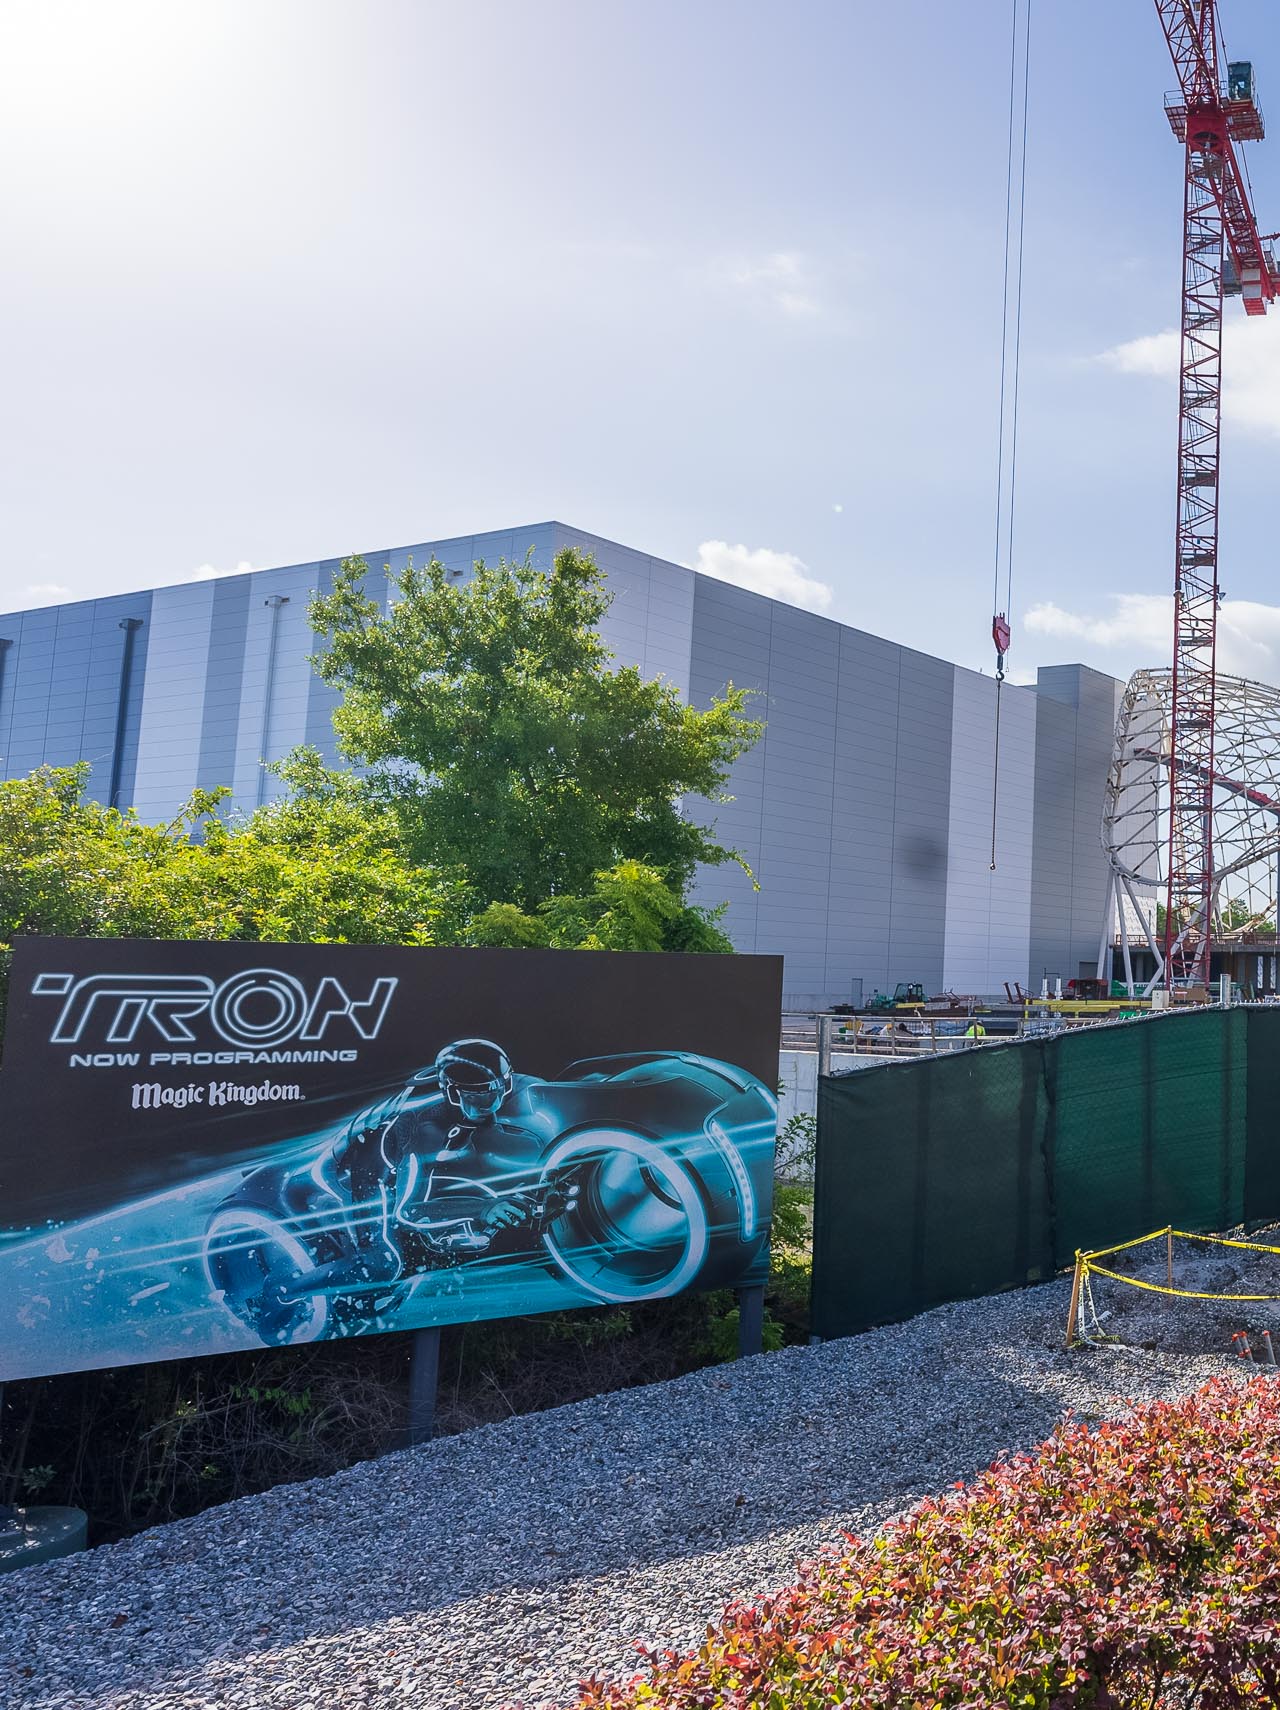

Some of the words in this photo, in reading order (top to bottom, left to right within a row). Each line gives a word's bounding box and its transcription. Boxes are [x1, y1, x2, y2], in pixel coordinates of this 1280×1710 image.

[32, 968, 398, 1049] TRON
[70, 1053, 140, 1067] NOW
[150, 1050, 358, 1066] PROGRAMMING
[131, 1082, 205, 1109] Magic
[208, 1079, 300, 1107] Kingdom
